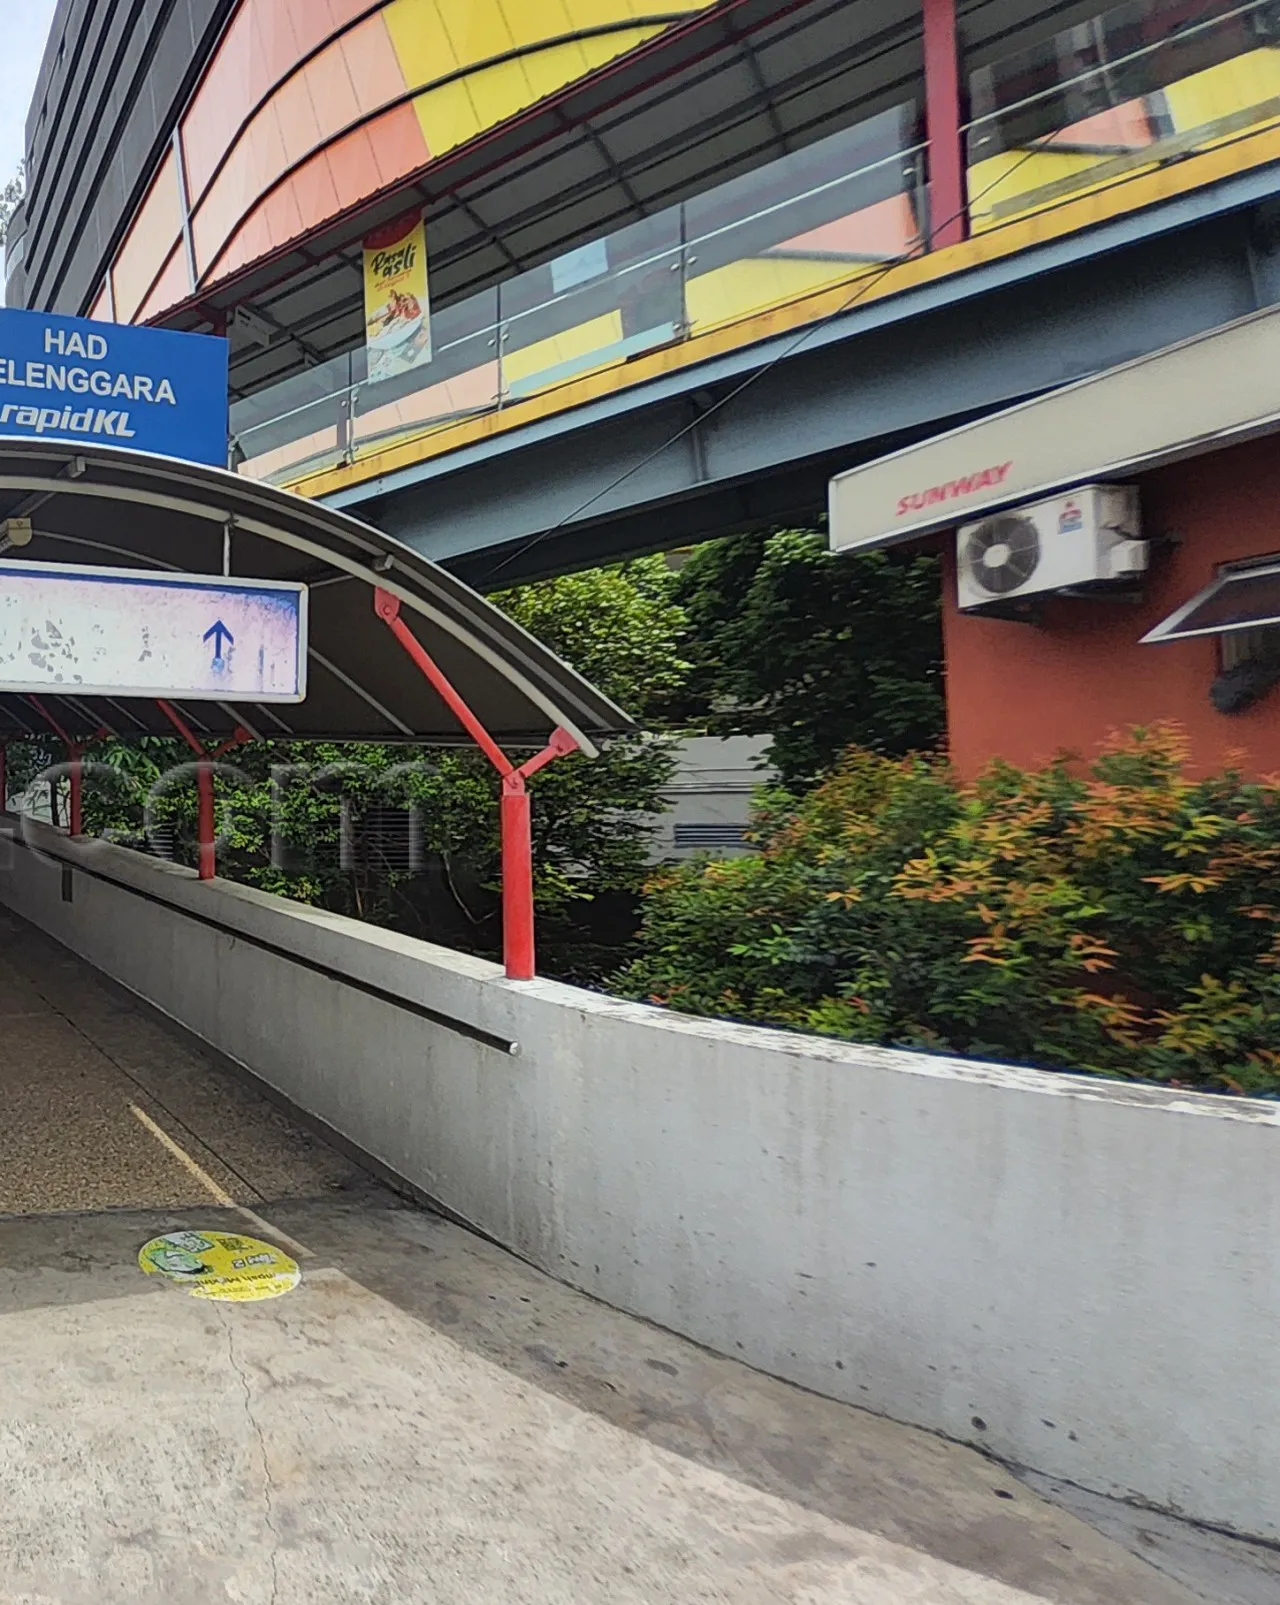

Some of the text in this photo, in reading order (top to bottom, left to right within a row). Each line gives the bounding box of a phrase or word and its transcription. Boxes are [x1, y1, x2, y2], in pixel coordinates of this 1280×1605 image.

[370, 247, 404, 276] Rasa
[382, 243, 417, 278] asli
[44, 327, 108, 361] HAD
[0, 402, 136, 438] rapidKL
[894, 460, 1014, 517] SUNWAY
